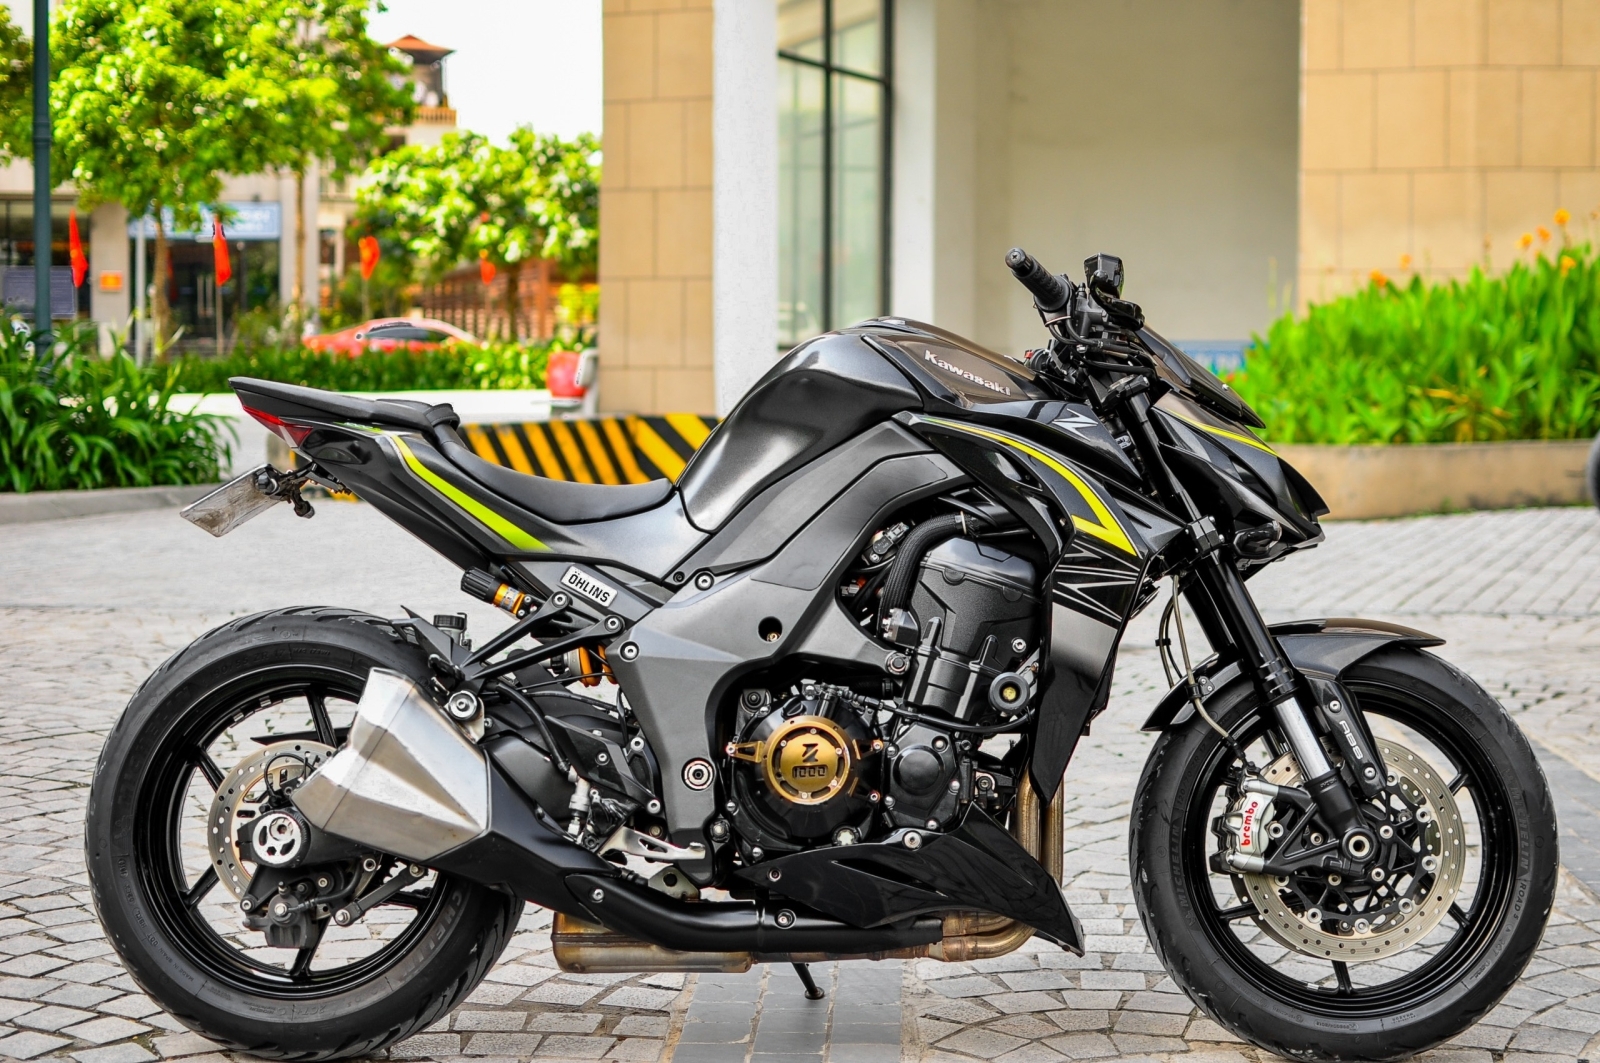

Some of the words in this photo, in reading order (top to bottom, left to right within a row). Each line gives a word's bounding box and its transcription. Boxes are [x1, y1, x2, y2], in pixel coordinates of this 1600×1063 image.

[924, 349, 1011, 396] Kawasaki
[568, 570, 611, 603] ÖHLINS
[1339, 720, 1363, 760] ABS
[794, 767, 826, 778] 1000
[1241, 801, 1258, 847] brembo
[1171, 824, 1190, 908] MICHELIN
[1512, 882, 1526, 912] ROAD
